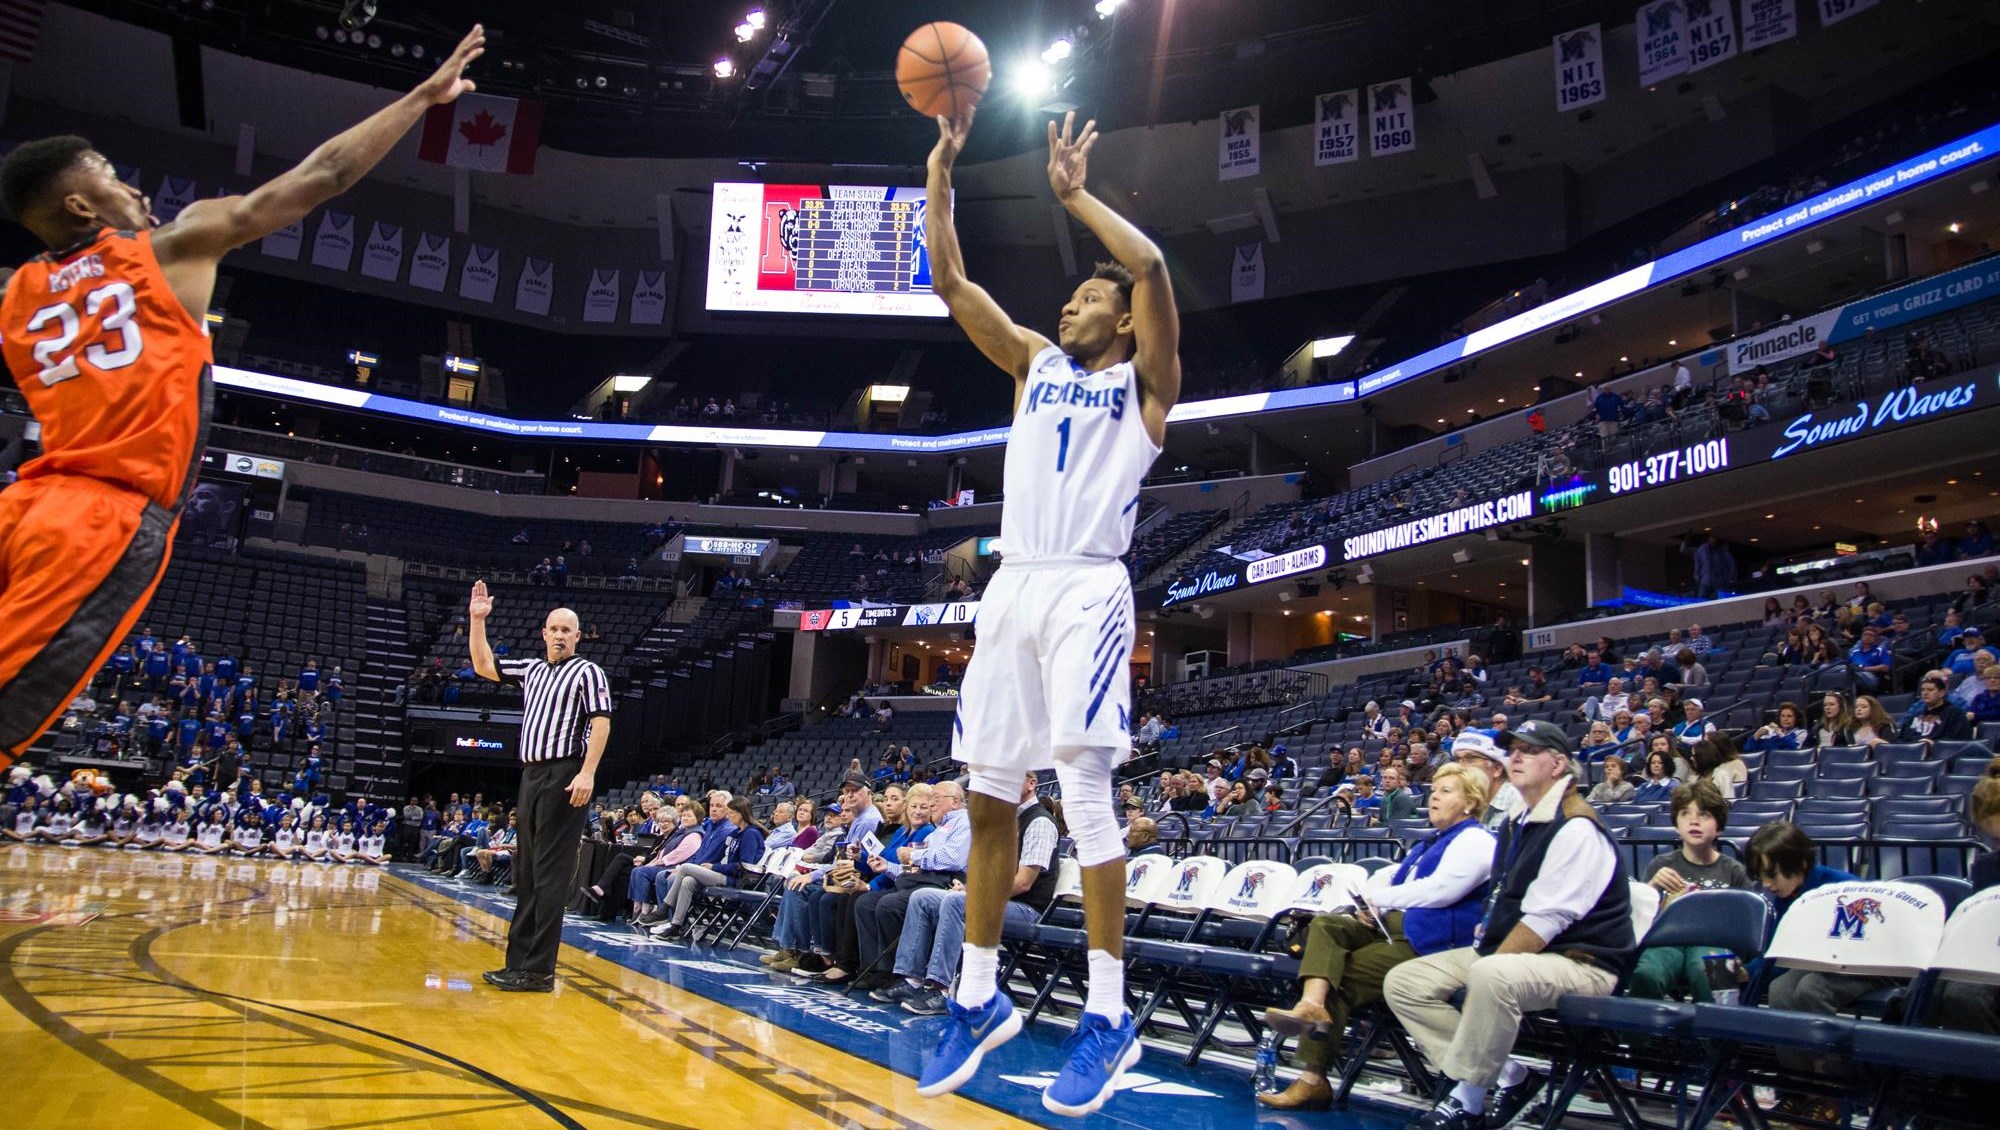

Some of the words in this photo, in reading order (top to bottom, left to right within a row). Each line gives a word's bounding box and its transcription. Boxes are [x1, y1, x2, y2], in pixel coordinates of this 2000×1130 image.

[1690, 16, 1725, 45] NIT
[1644, 31, 1679, 53] NCAA
[1690, 35, 1731, 65] 1967
[1648, 44, 1677, 65] 1964
[1563, 62, 1595, 85] NIT
[1560, 80, 1602, 104] 1963
[1321, 123, 1351, 139] NIT
[1376, 113, 1406, 132] NIT
[1227, 139, 1251, 151] NCAA
[1319, 135, 1355, 151] 1957
[1373, 130, 1412, 150] 1960
[1229, 149, 1250, 160] 1955
[1319, 148, 1354, 160] FINALS
[834, 189, 856, 200] TEAM
[857, 190, 882, 200] STATS
[1741, 217, 1784, 242] Protect
[1784, 208, 1808, 226] and
[1809, 187, 1864, 216] maintain
[1864, 174, 1896, 197] your
[1896, 159, 1938, 182] home
[1938, 141, 1984, 165] court.
[834, 202, 854, 211] FIELD
[856, 202, 880, 211] GOALS
[832, 221, 850, 230] FREE
[851, 221, 880, 231] THROWS
[845, 212, 862, 221] FIELD
[863, 212, 883, 221] GOALS
[840, 231, 871, 240] ASSISTS
[834, 241, 875, 251] REBOUNDS
[827, 251, 842, 260] OFF
[842, 251, 881, 261] REBOUNDS
[840, 261, 868, 270] STEALS
[838, 270, 868, 280] BLOCKS
[831, 280, 876, 291] TURNOVERS
[1852, 312, 1871, 326] GET
[1873, 303, 1901, 319] YOUR
[1902, 288, 1943, 311] GRIZZ
[1946, 276, 1984, 298] CARD
[26, 281, 145, 388] 23
[1736, 324, 1817, 365] Pinnacle
[1025, 381, 1126, 421] MEMPHIS
[439, 410, 469, 422] Protect
[469, 416, 485, 425] and
[485, 420, 520, 431] maintain
[520, 425, 539, 433] your
[538, 424, 560, 433] home
[1771, 403, 1868, 459] Sound
[1872, 383, 1976, 427] Waves
[891, 438, 921, 447] Protect
[921, 440, 938, 448] and
[938, 437, 967, 447] maintain
[966, 435, 983, 445] your
[983, 432, 1003, 442] home
[1056, 417, 1072, 472] 1
[1609, 438, 1728, 494] 901-377-1001
[1344, 491, 1533, 560] SOUNDWAVESMEMPHIS.COM
[1251, 566, 1265, 580] CAR
[1265, 558, 1286, 575] AUDIO
[1291, 549, 1320, 569] ALARMS
[1162, 577, 1200, 607] Sound
[1199, 571, 1237, 593] Waves
[841, 611, 848, 627] 5
[864, 609, 892, 618] TIMEOUTS:
[953, 604, 966, 621] 10
[1537, 633, 1551, 646] 114
[456, 737, 503, 749] FedExForum
[1895, 891, 1929, 910] Guest
